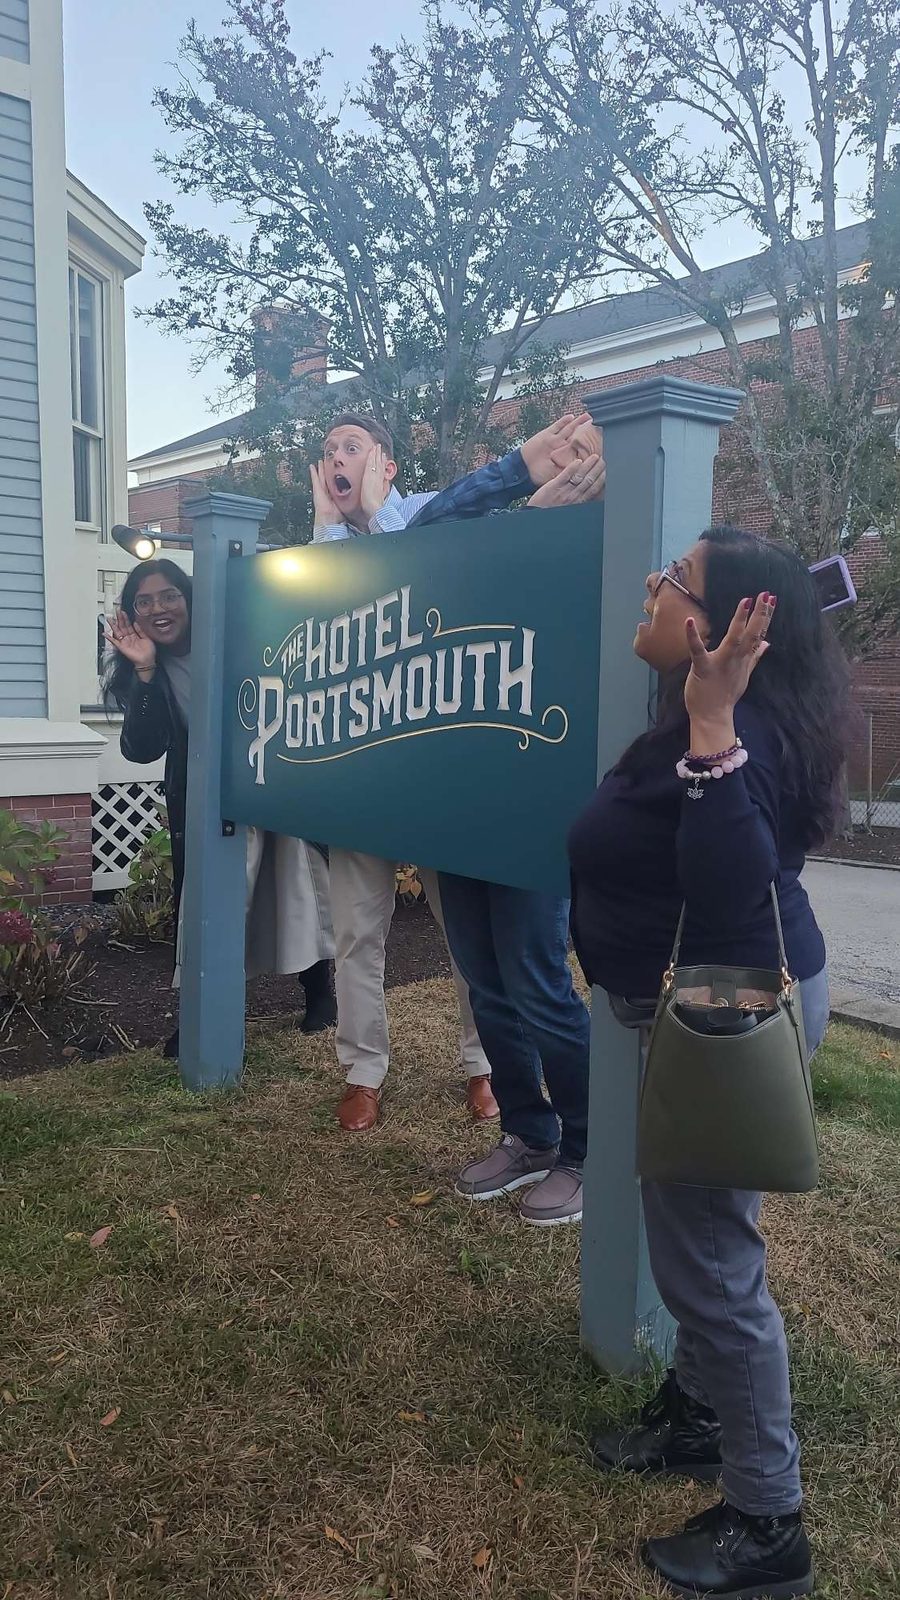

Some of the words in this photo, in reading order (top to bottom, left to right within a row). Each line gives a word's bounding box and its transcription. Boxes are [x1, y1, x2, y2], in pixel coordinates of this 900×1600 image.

[281, 632, 304, 676] THE
[304, 585, 424, 682] HOTEL
[248, 627, 536, 785] PORTSMOUTH
